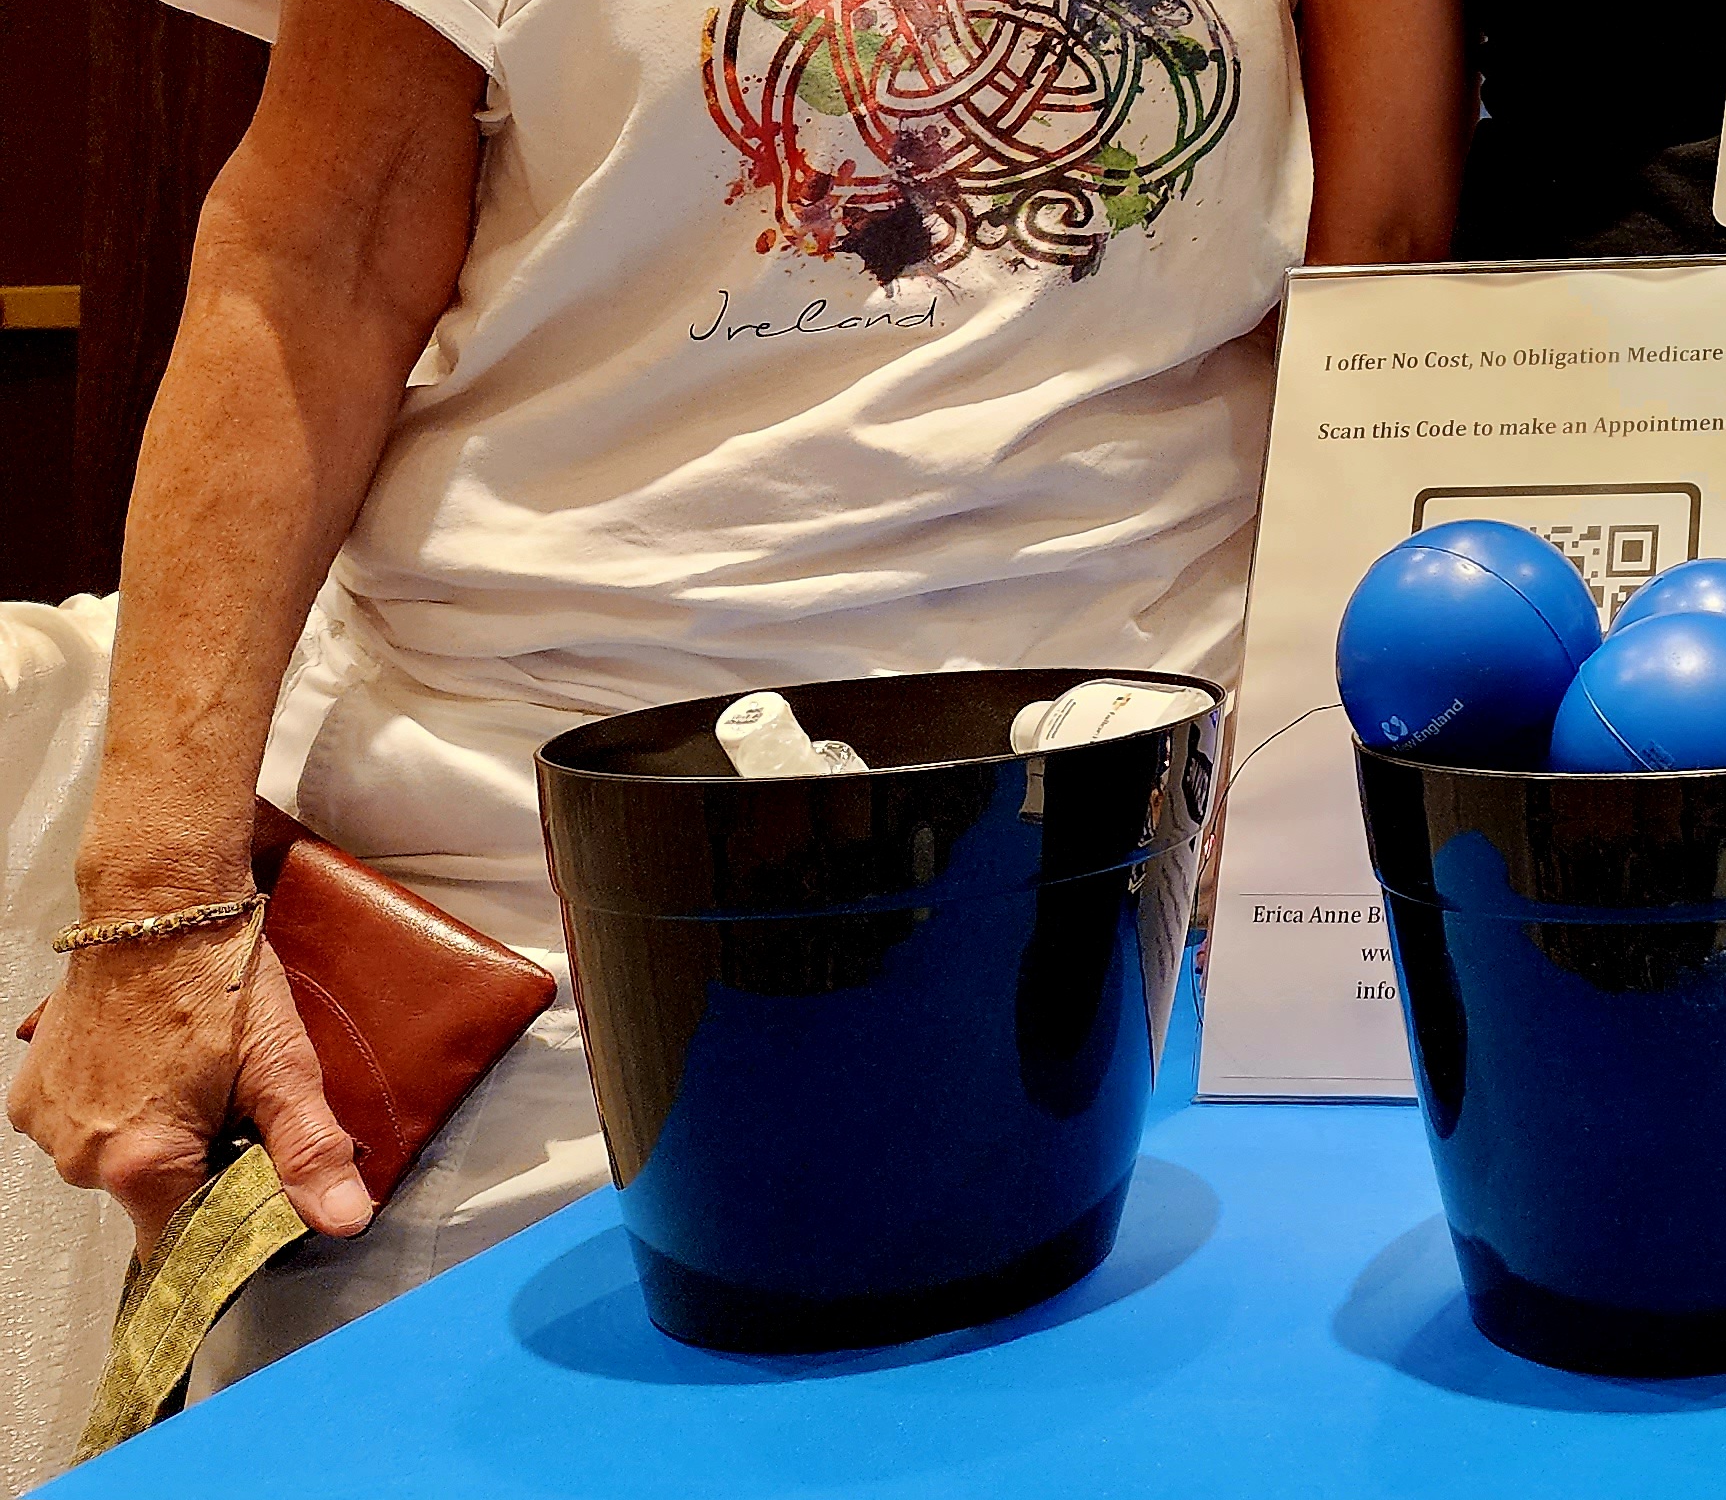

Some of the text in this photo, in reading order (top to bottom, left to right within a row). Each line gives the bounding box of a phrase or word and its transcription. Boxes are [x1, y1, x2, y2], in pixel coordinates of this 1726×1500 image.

[1323, 355, 1333, 372] I
[1336, 353, 1387, 372] offer
[1390, 353, 1420, 371] No
[1424, 351, 1474, 371] Cost,
[1479, 349, 1508, 368] No
[1512, 347, 1621, 371] Obligation
[1627, 344, 1724, 364] Medicare
[1317, 422, 1366, 441] Scan
[1372, 420, 1410, 440] this
[1415, 419, 1467, 439] Code
[1472, 421, 1494, 438] to
[1499, 417, 1557, 437] make
[1562, 420, 1588, 435] an
[1412, 698, 1465, 743] England
[1252, 904, 1385, 925] Erica Anne B
